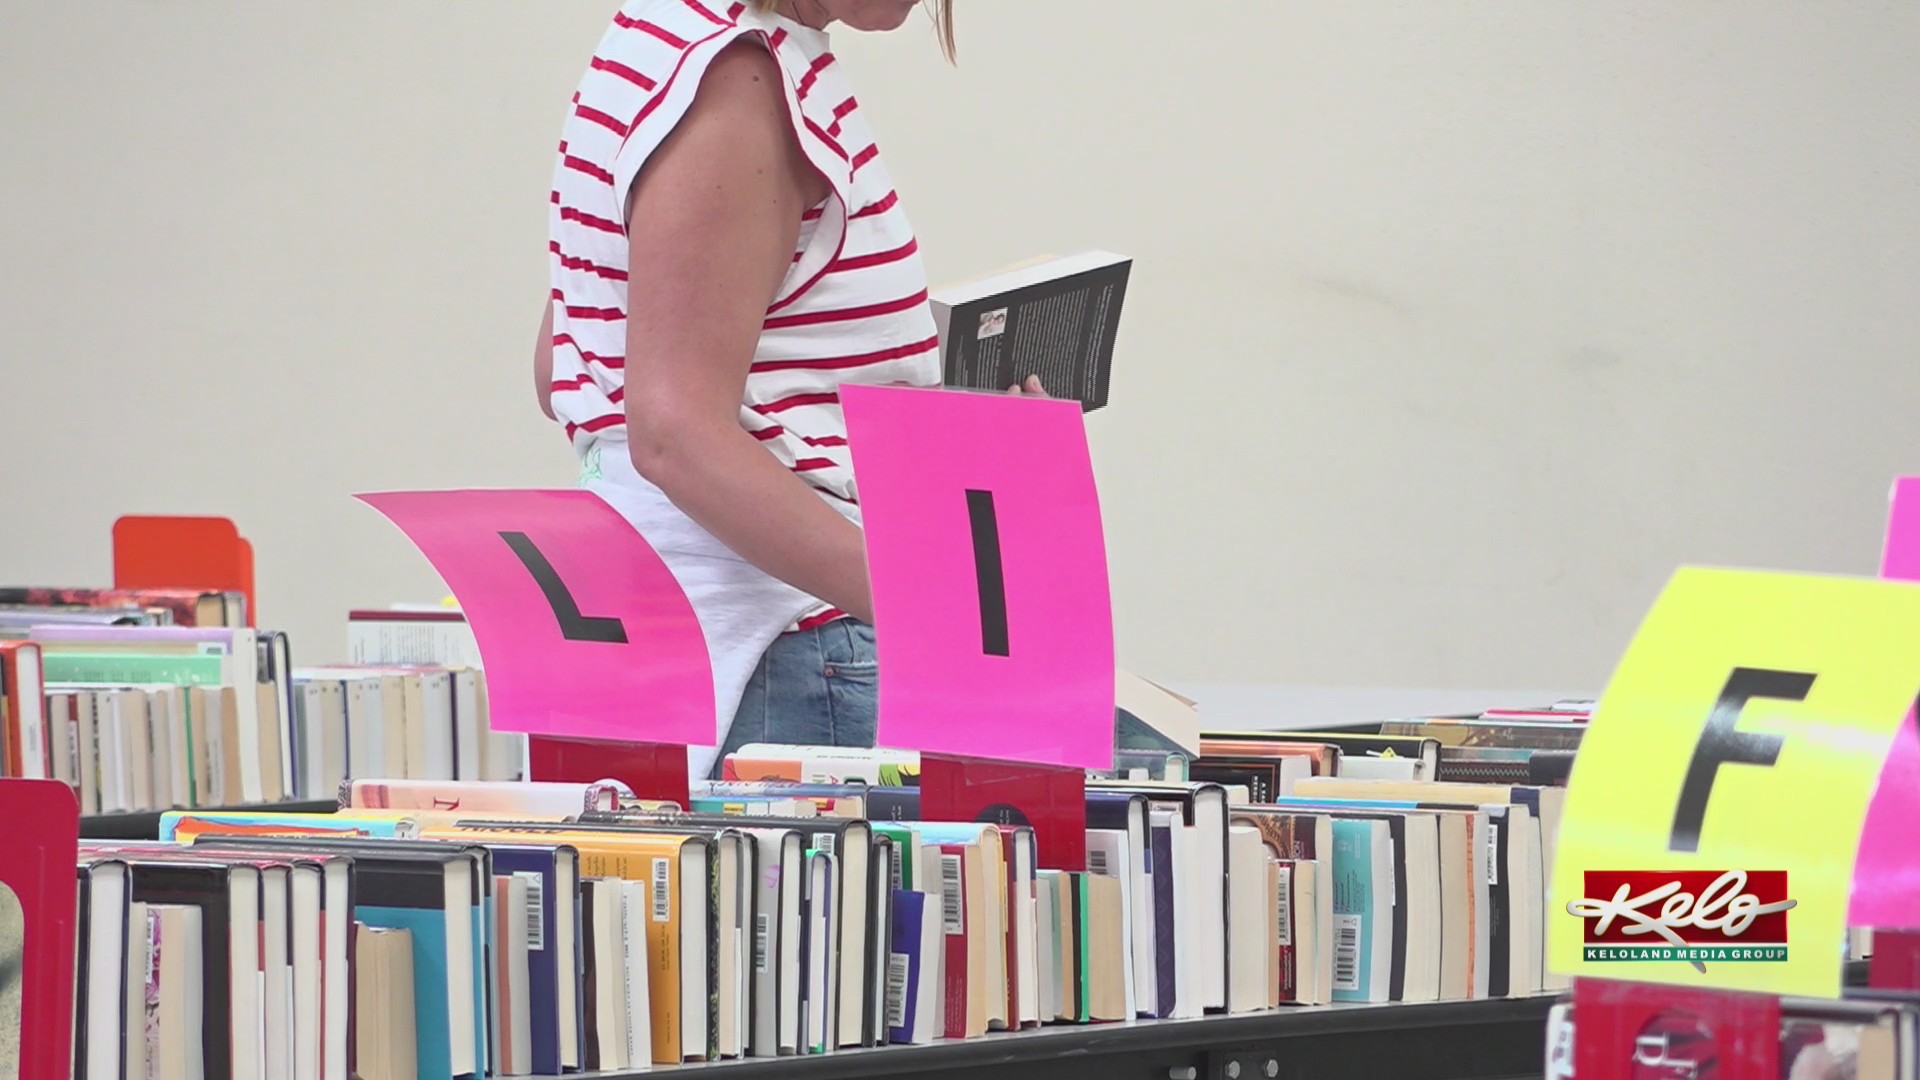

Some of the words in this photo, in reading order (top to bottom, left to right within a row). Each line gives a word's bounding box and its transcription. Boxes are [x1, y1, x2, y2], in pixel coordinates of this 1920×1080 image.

[496, 531, 629, 644] L
[965, 489, 1010, 658] I
[1667, 667, 1818, 852] F
